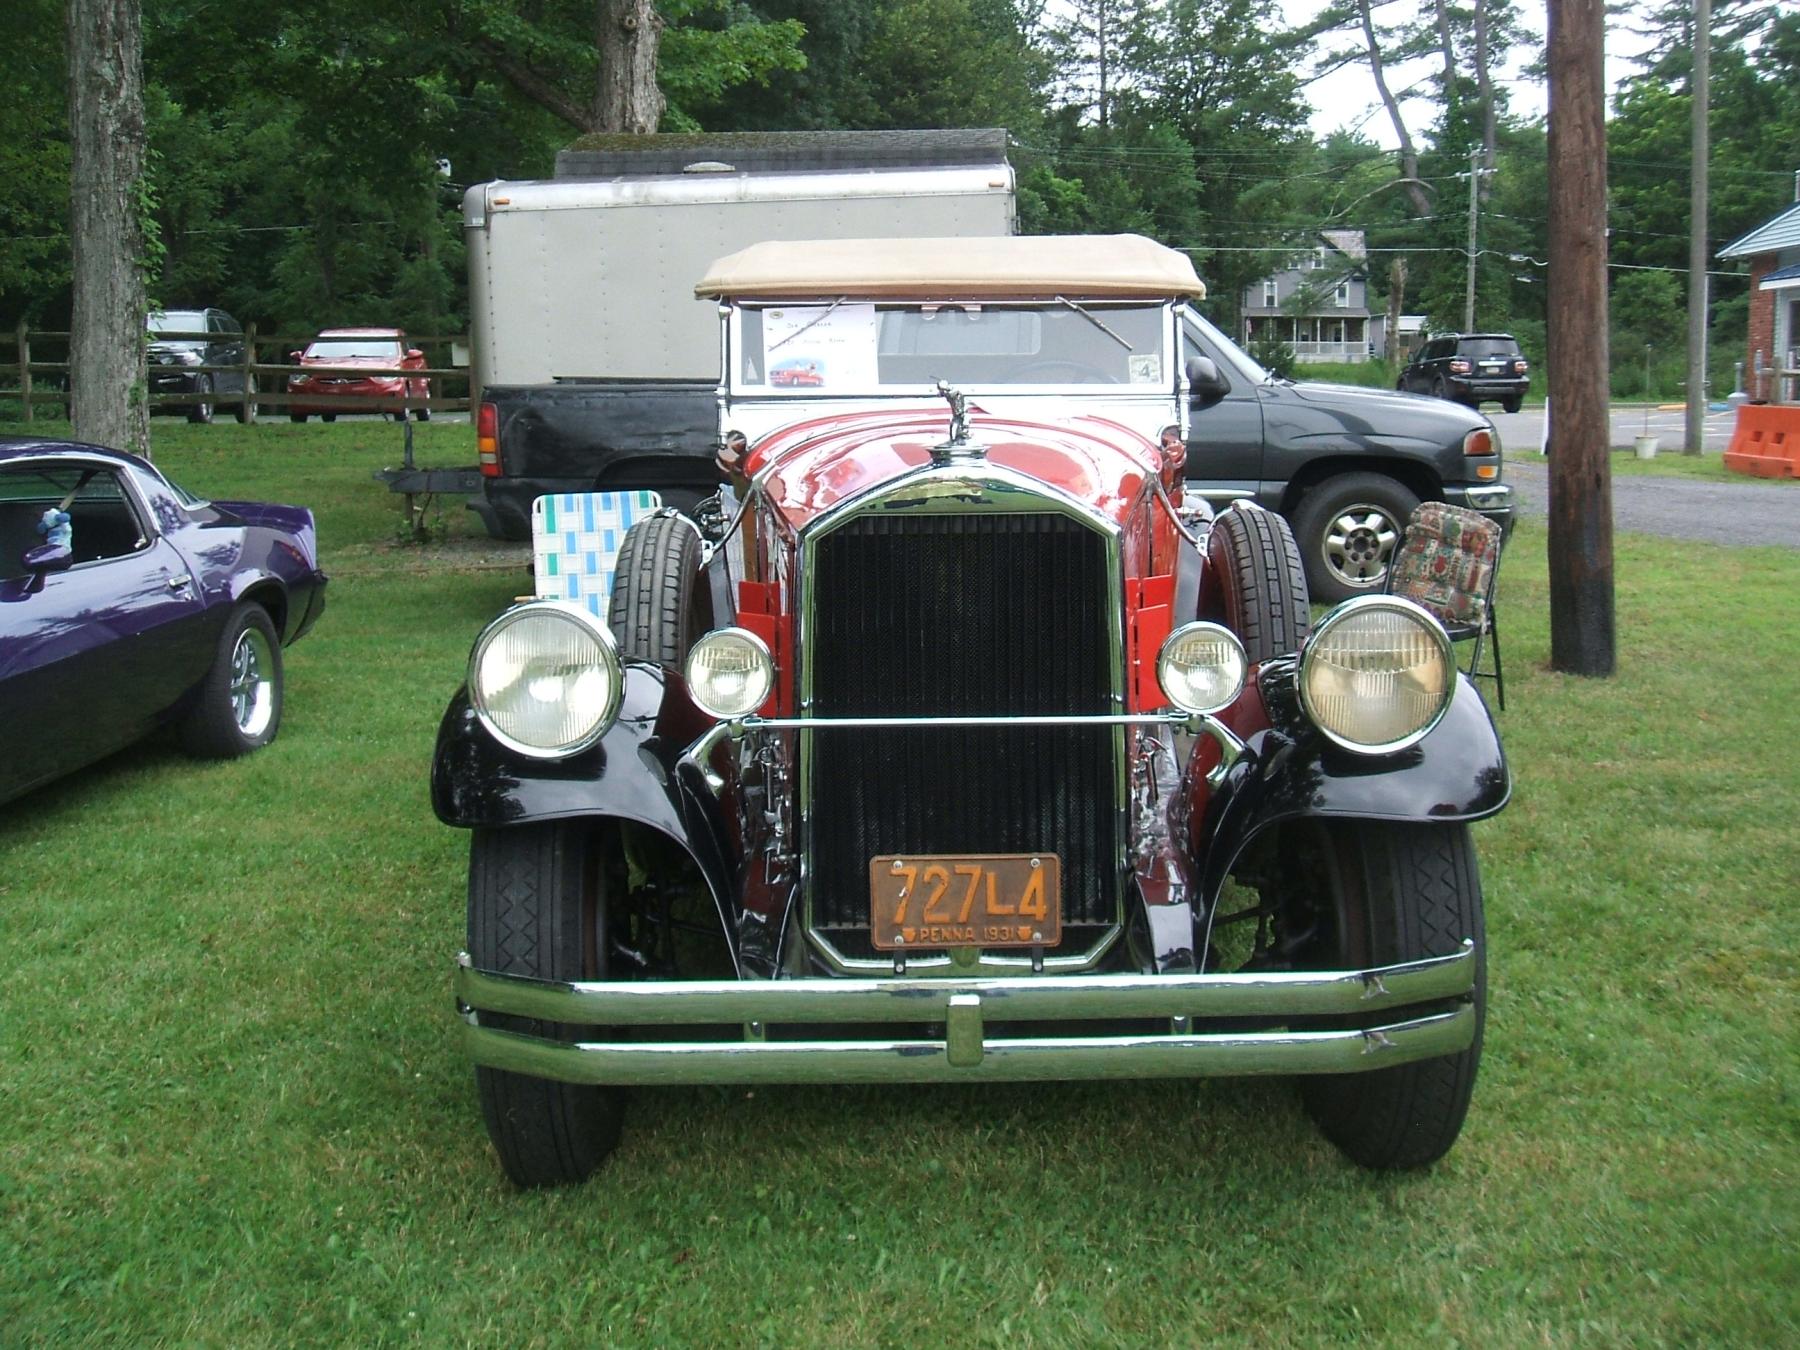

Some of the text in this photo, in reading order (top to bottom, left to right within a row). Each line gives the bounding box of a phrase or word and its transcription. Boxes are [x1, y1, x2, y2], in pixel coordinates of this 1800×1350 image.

[889, 864, 1048, 924] 727L4
[919, 927, 1015, 941] PENNA 1931
